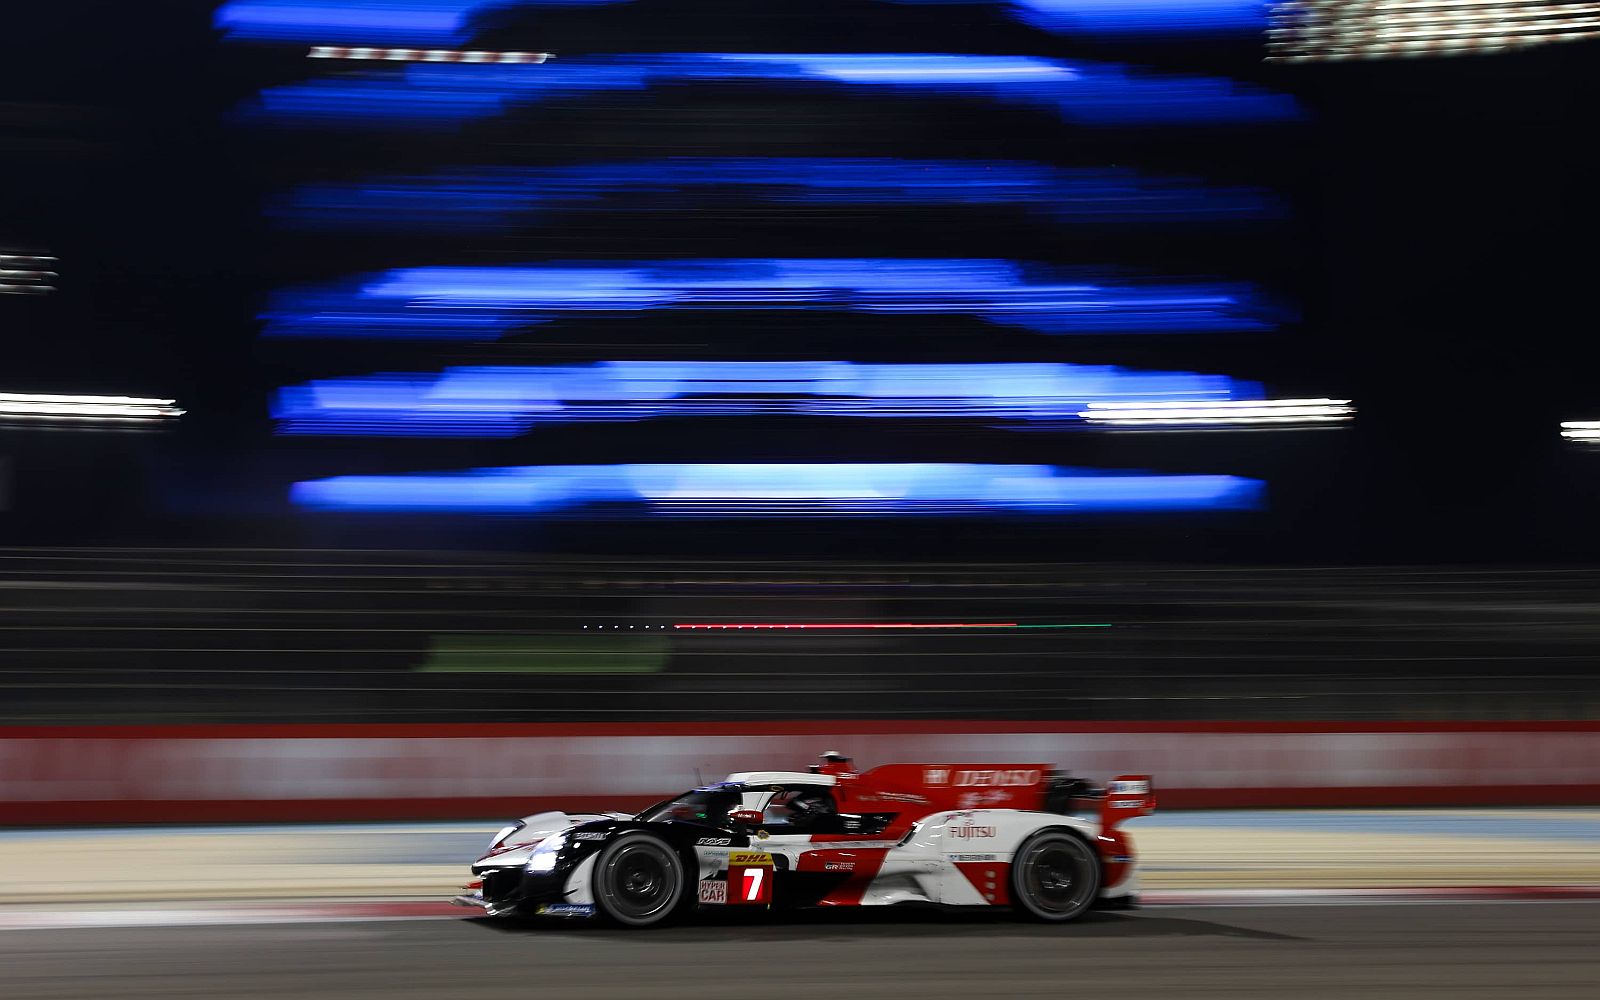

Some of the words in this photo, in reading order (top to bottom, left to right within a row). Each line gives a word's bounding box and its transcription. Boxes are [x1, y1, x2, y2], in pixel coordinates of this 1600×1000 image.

[949, 826, 996, 841] FUJITSU
[735, 854, 767, 862] DHL
[701, 881, 725, 889] HYPER
[744, 868, 764, 901] 7
[702, 889, 725, 901] CAR
